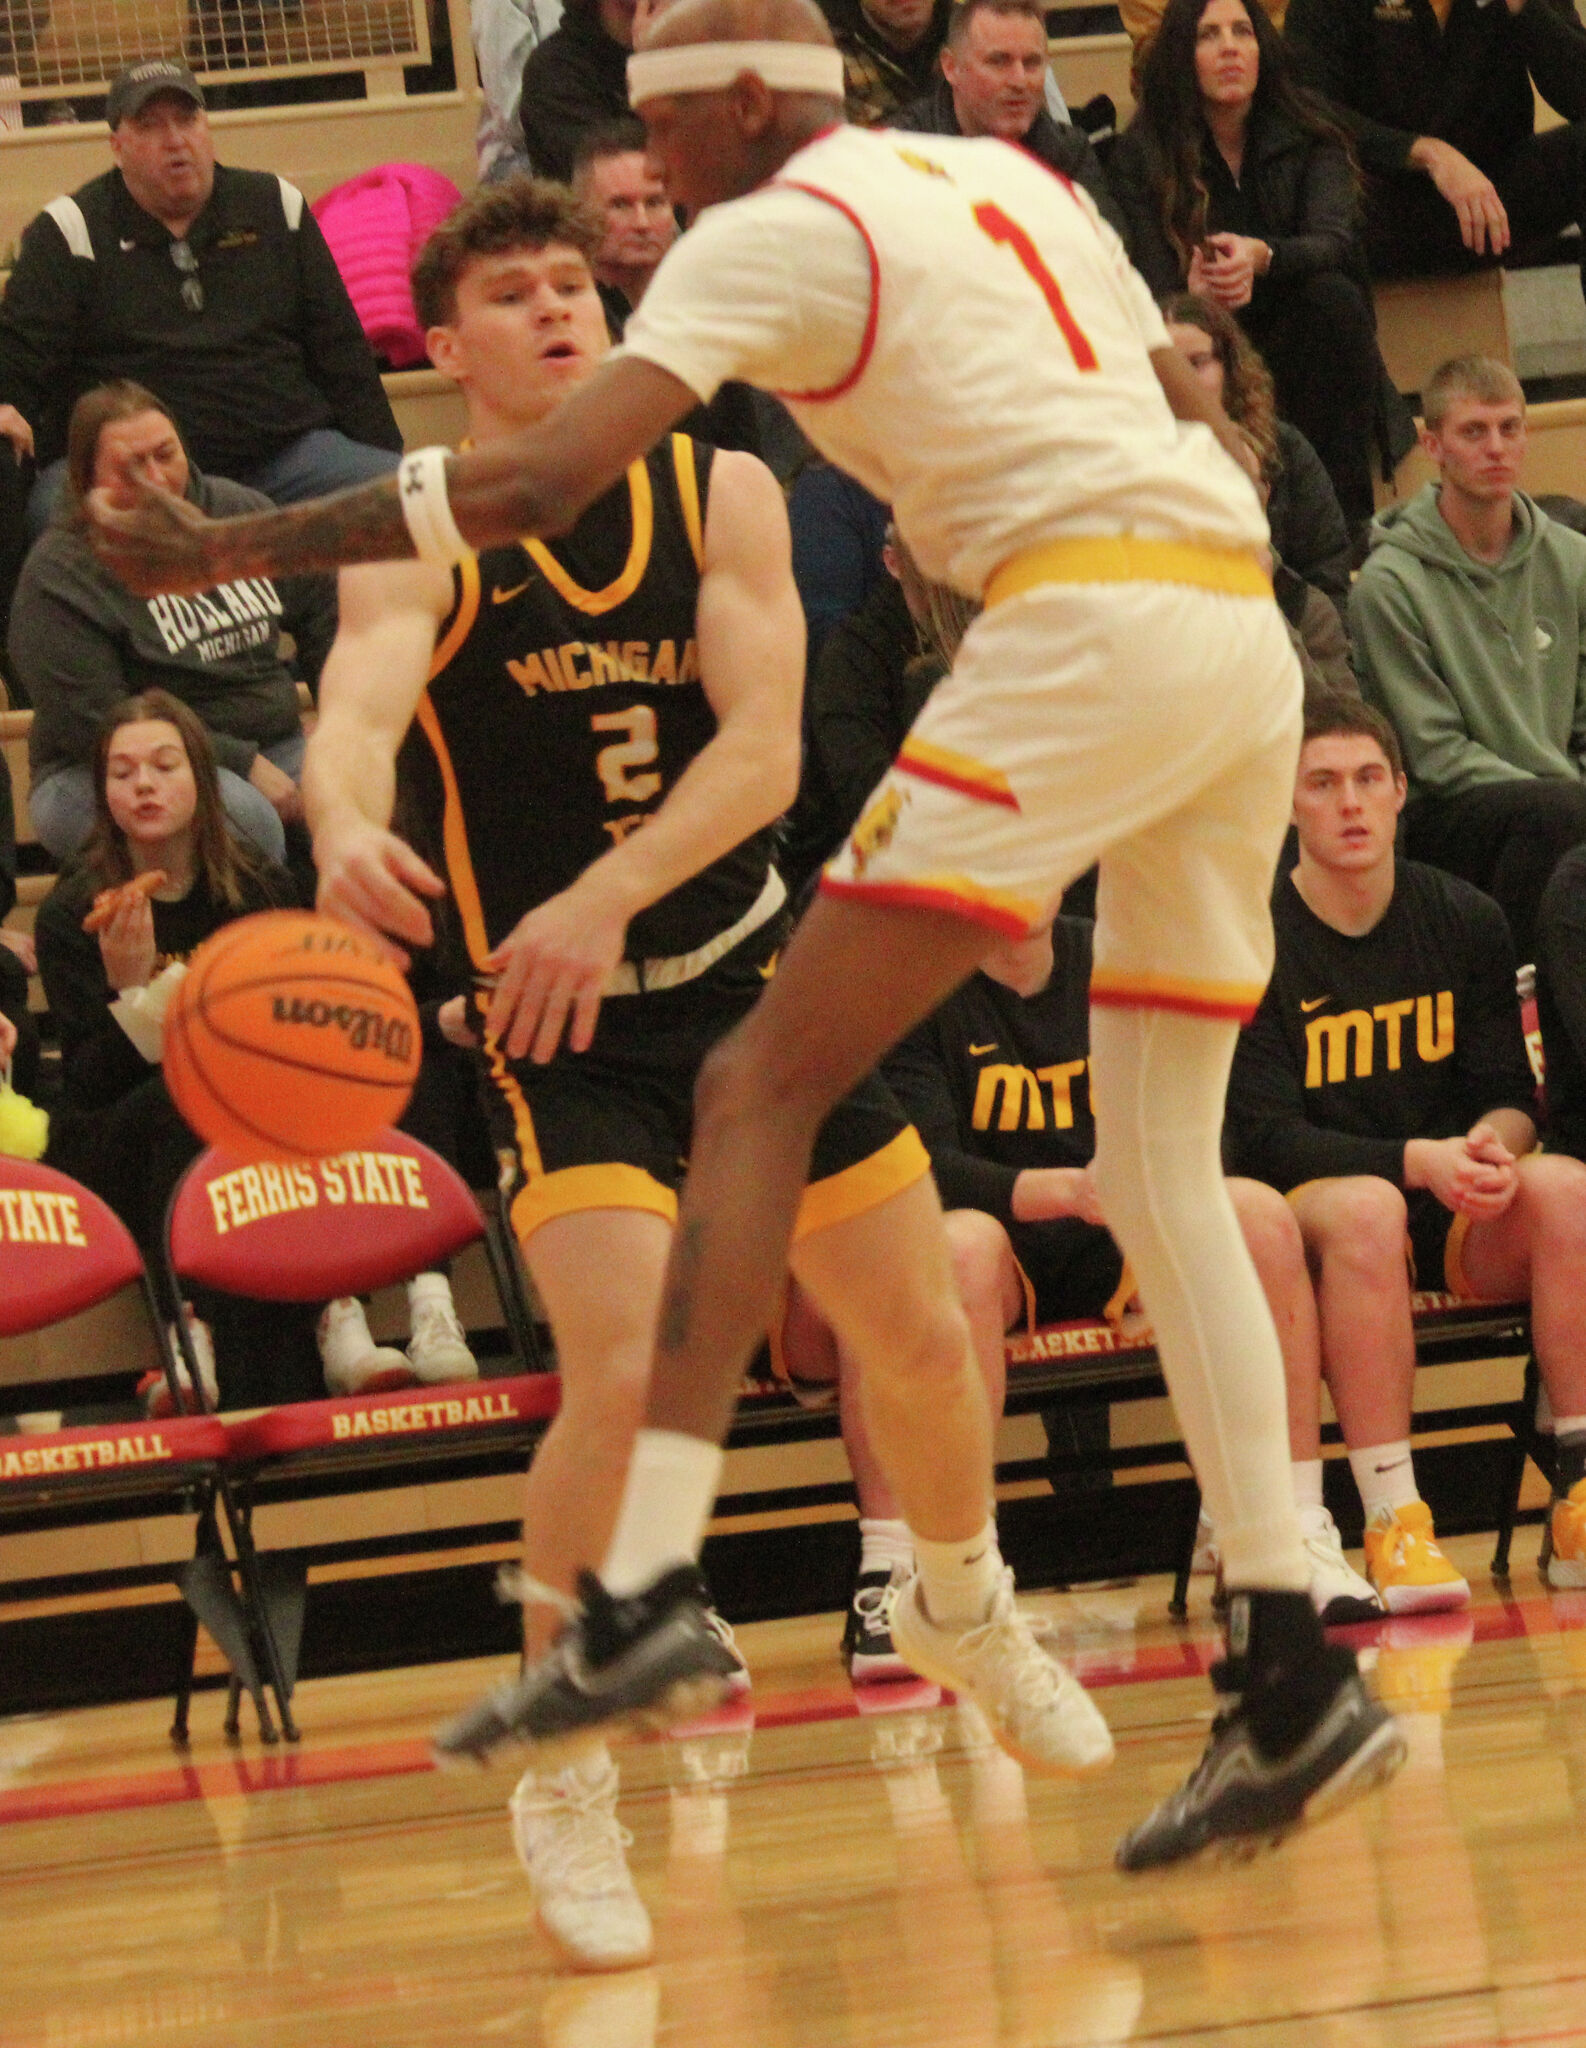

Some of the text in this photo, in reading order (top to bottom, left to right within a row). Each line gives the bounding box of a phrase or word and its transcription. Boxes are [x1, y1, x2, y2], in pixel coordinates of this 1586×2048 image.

[971, 199, 1101, 374] 1
[591, 705, 662, 803] 2
[272, 997, 413, 1063] Wilson
[1305, 990, 1455, 1089] MTU
[971, 1055, 1096, 1131] MT
[0, 1188, 88, 1248] TATE
[206, 1151, 430, 1235] FERRIS STATE
[331, 1393, 519, 1439] BASKETBALL
[0, 1433, 172, 1478] ASKETBALL
